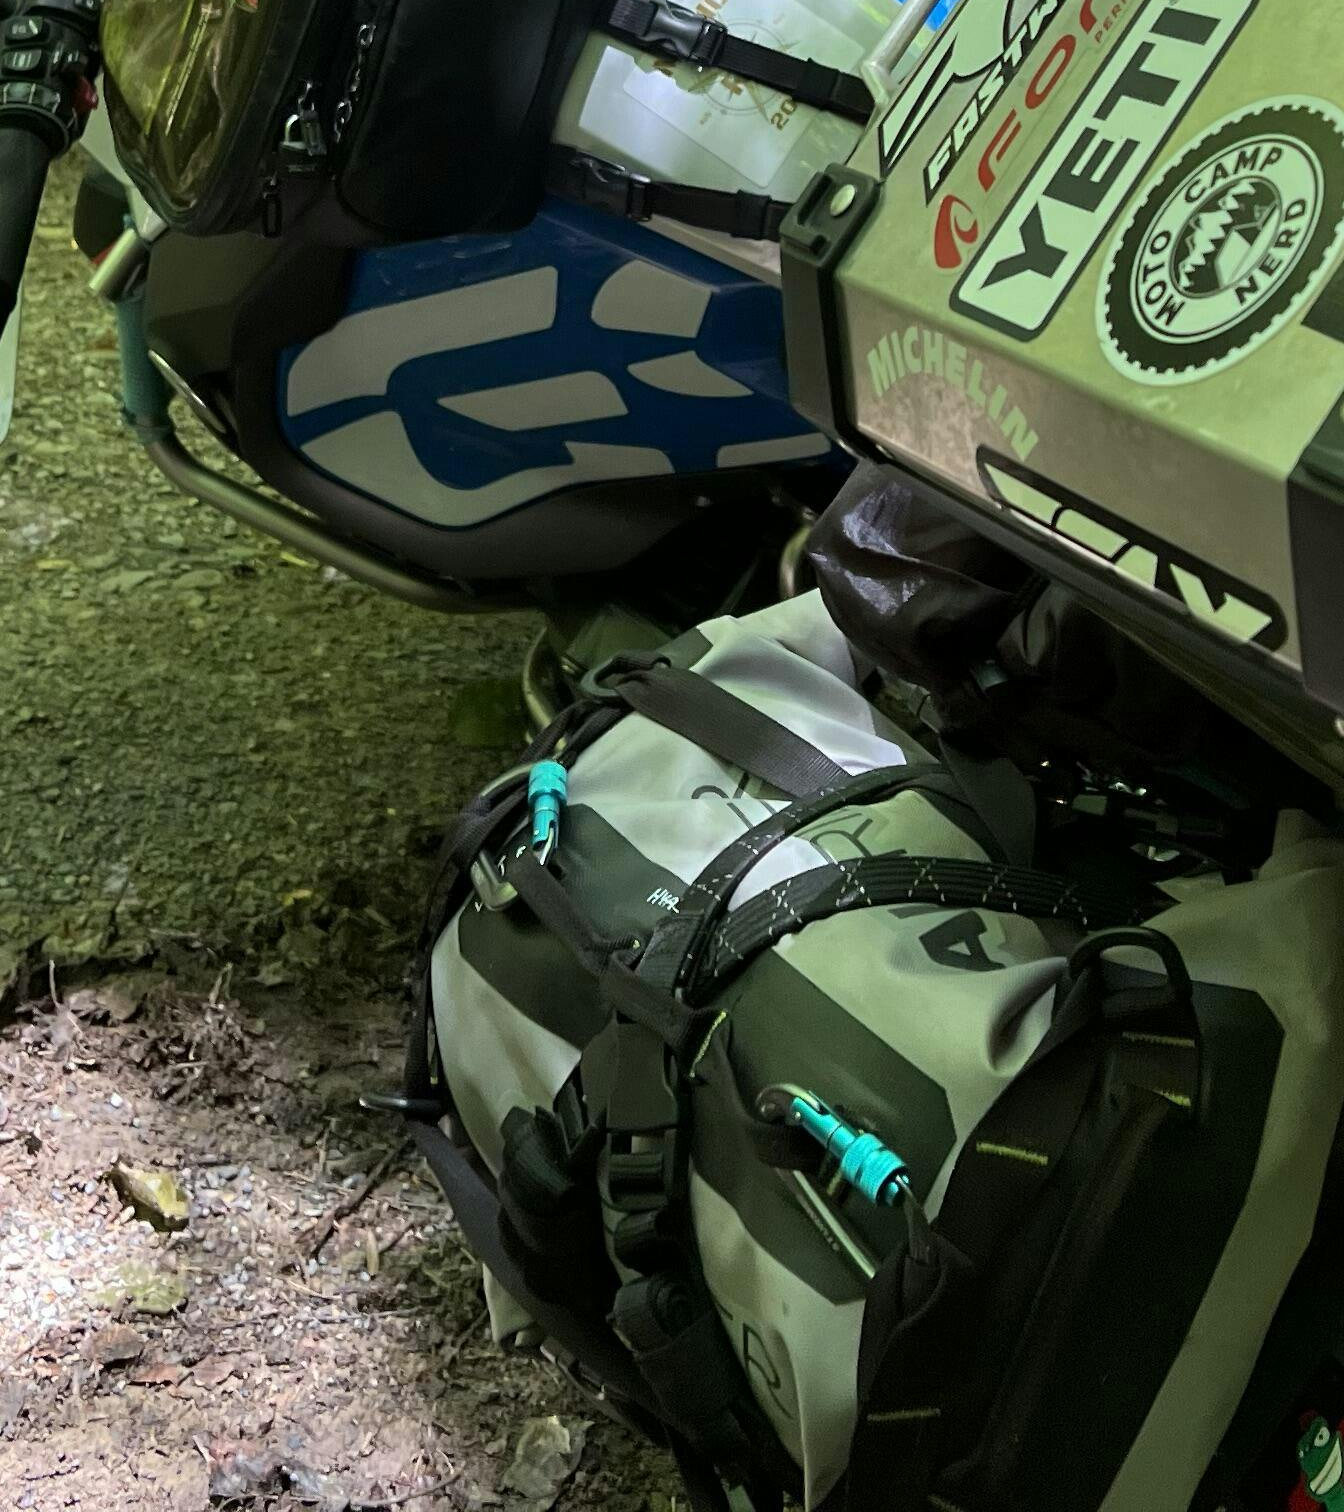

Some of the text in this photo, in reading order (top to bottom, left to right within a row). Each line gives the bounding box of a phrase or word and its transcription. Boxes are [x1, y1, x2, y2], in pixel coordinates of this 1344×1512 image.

[980, 6, 1222, 289] YETI
[1142, 146, 1307, 327] MOTO CAMP NERD
[866, 325, 1040, 463] MICHELIN
